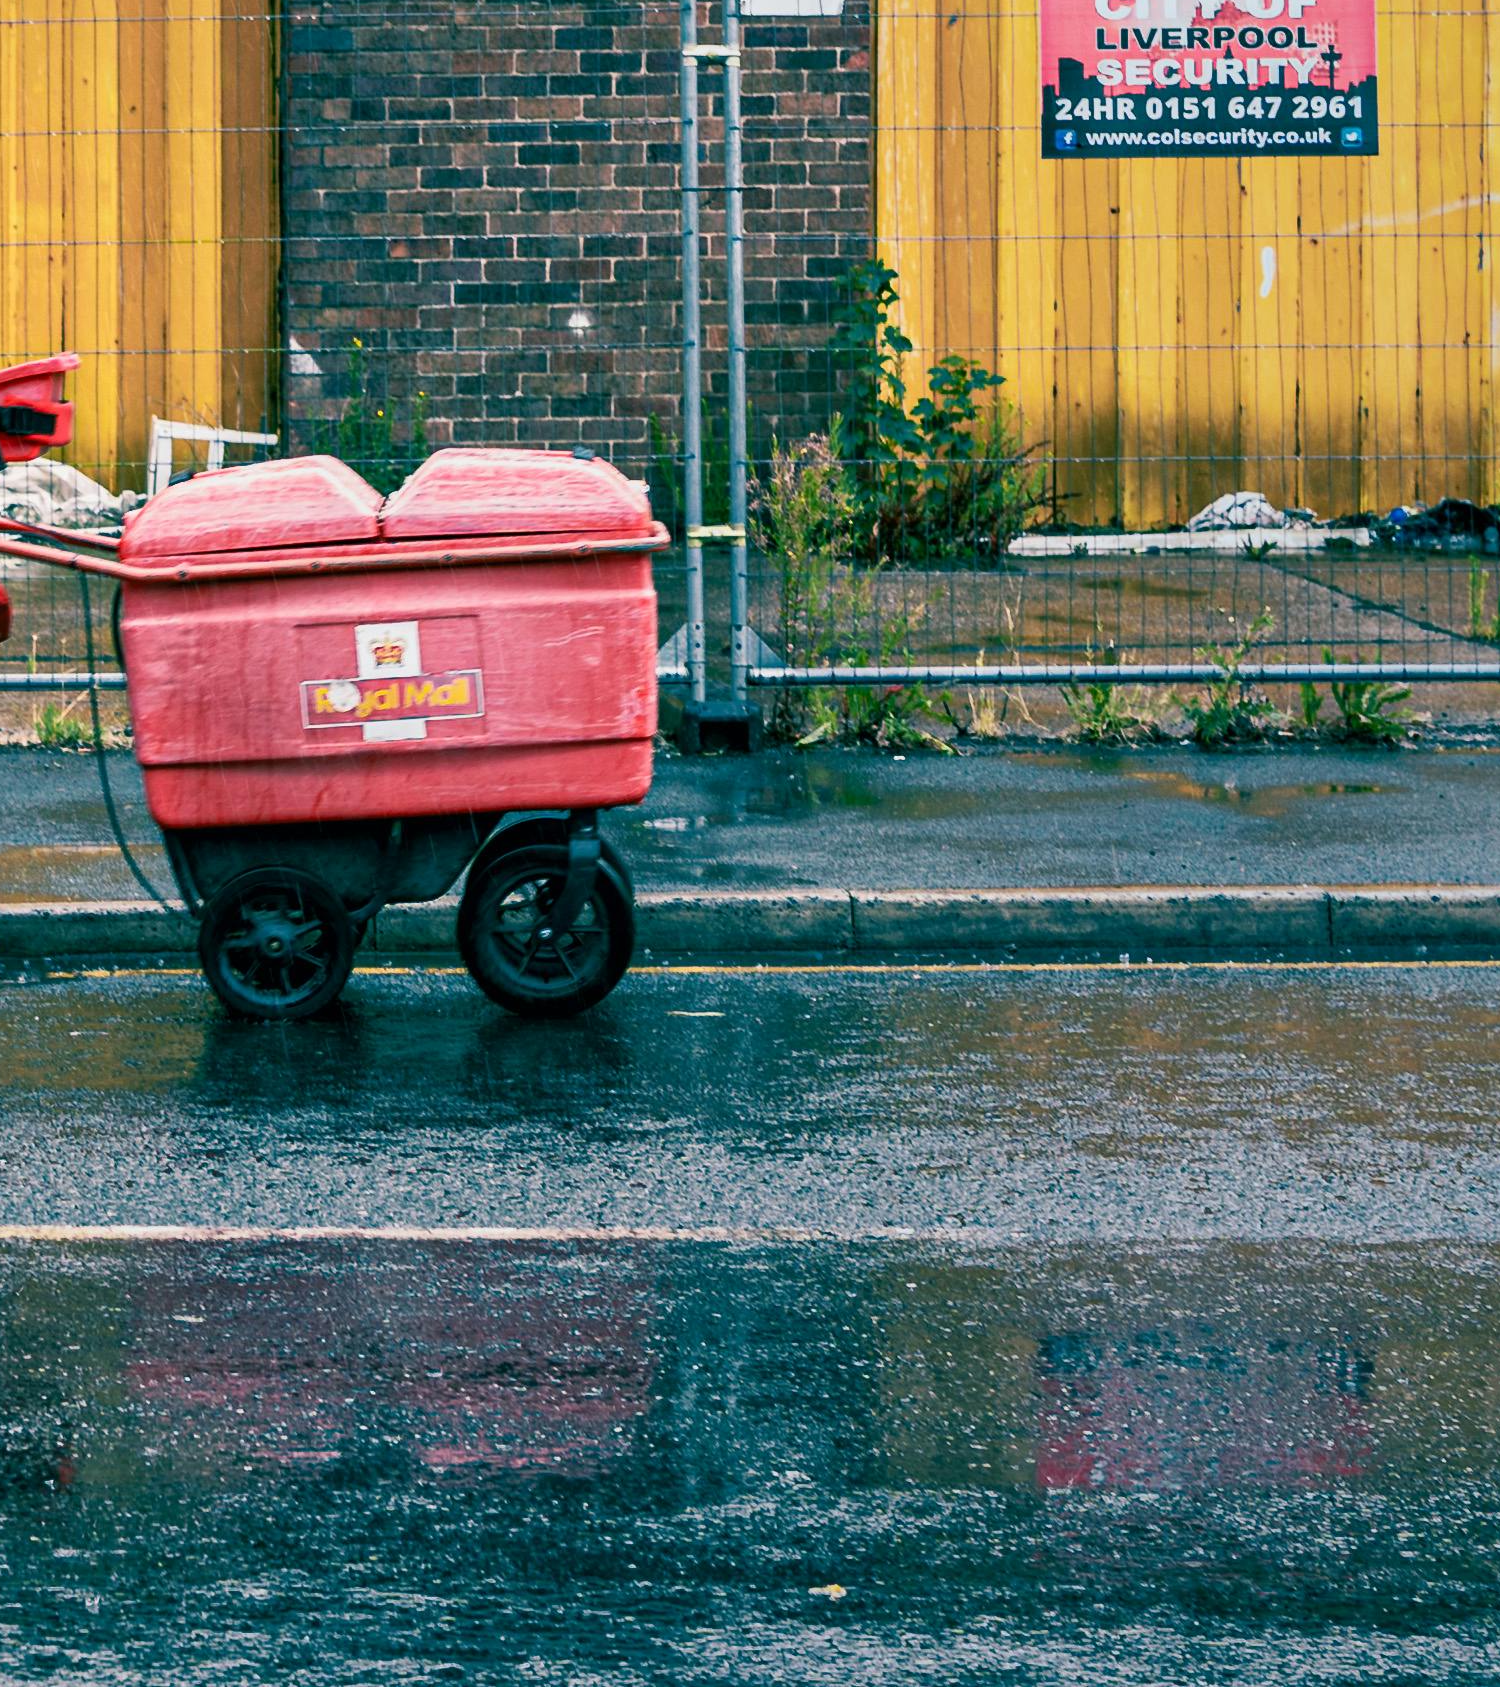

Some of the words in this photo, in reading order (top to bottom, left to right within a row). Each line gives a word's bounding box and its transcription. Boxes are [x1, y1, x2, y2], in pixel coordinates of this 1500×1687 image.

[1096, 25, 1318, 50] LIVERPOOL
[1096, 57, 1317, 87] SECURITY
[1055, 97, 1137, 121] 24HR
[1145, 97, 1216, 121] 0151
[1227, 96, 1283, 120] 647
[1291, 96, 1363, 120] 2961
[1086, 128, 1332, 149] www.colsecurity.co.uk
[314, 683, 399, 718] Ryal
[403, 677, 470, 709] Mail
